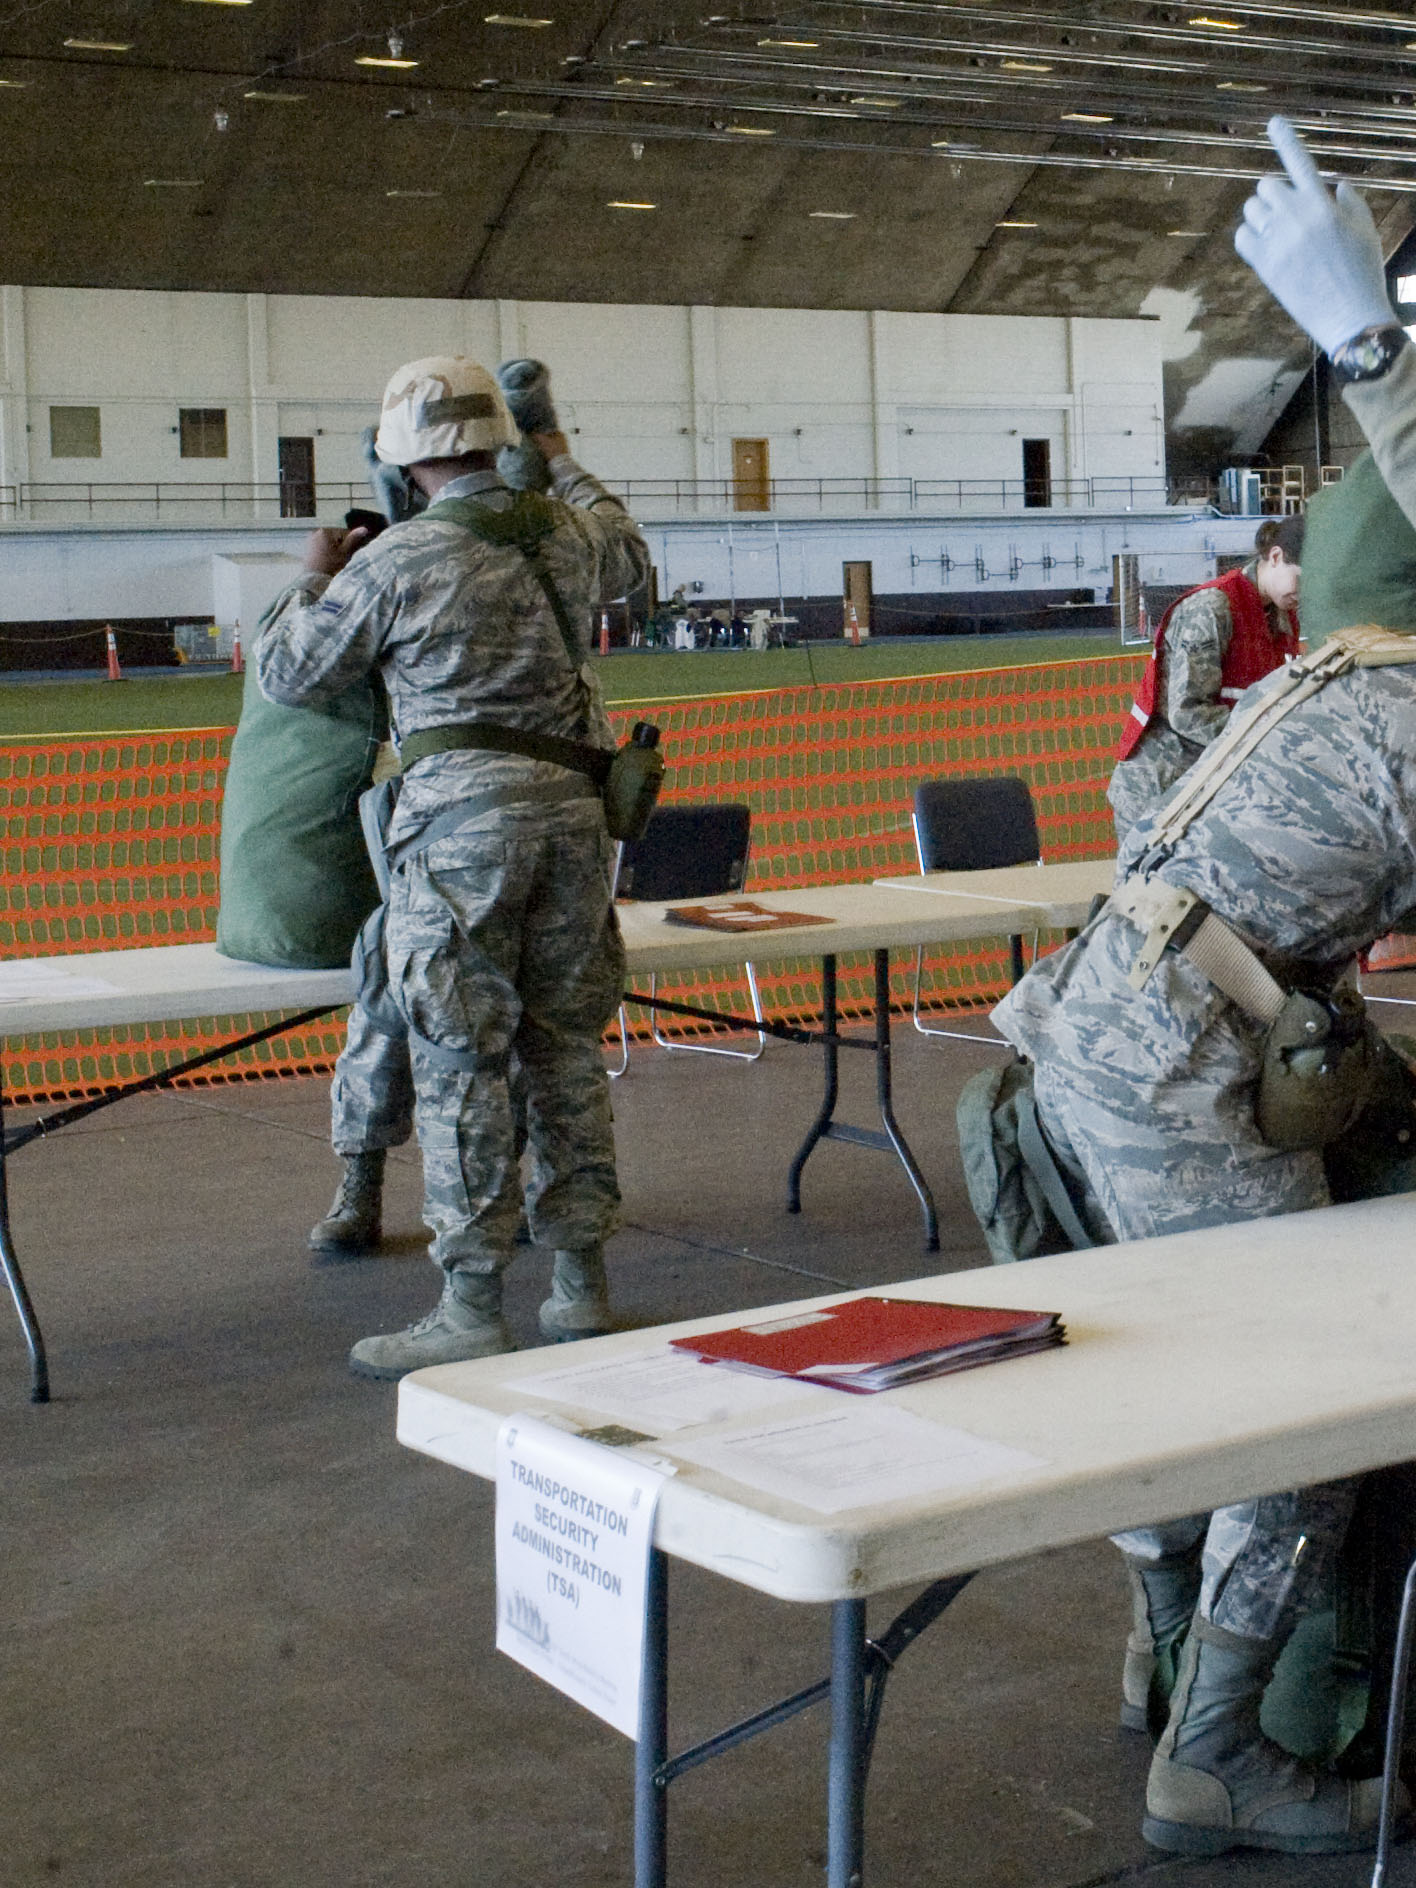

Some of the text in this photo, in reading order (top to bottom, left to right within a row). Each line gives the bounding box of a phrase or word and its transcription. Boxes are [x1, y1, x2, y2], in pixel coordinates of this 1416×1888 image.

[510, 1460, 628, 1536] TRANSPORTATION
[534, 1503, 599, 1552] SECURITY
[512, 1521, 622, 1597] ADMINISTRATION
[547, 1568, 580, 1609] (TSA)
